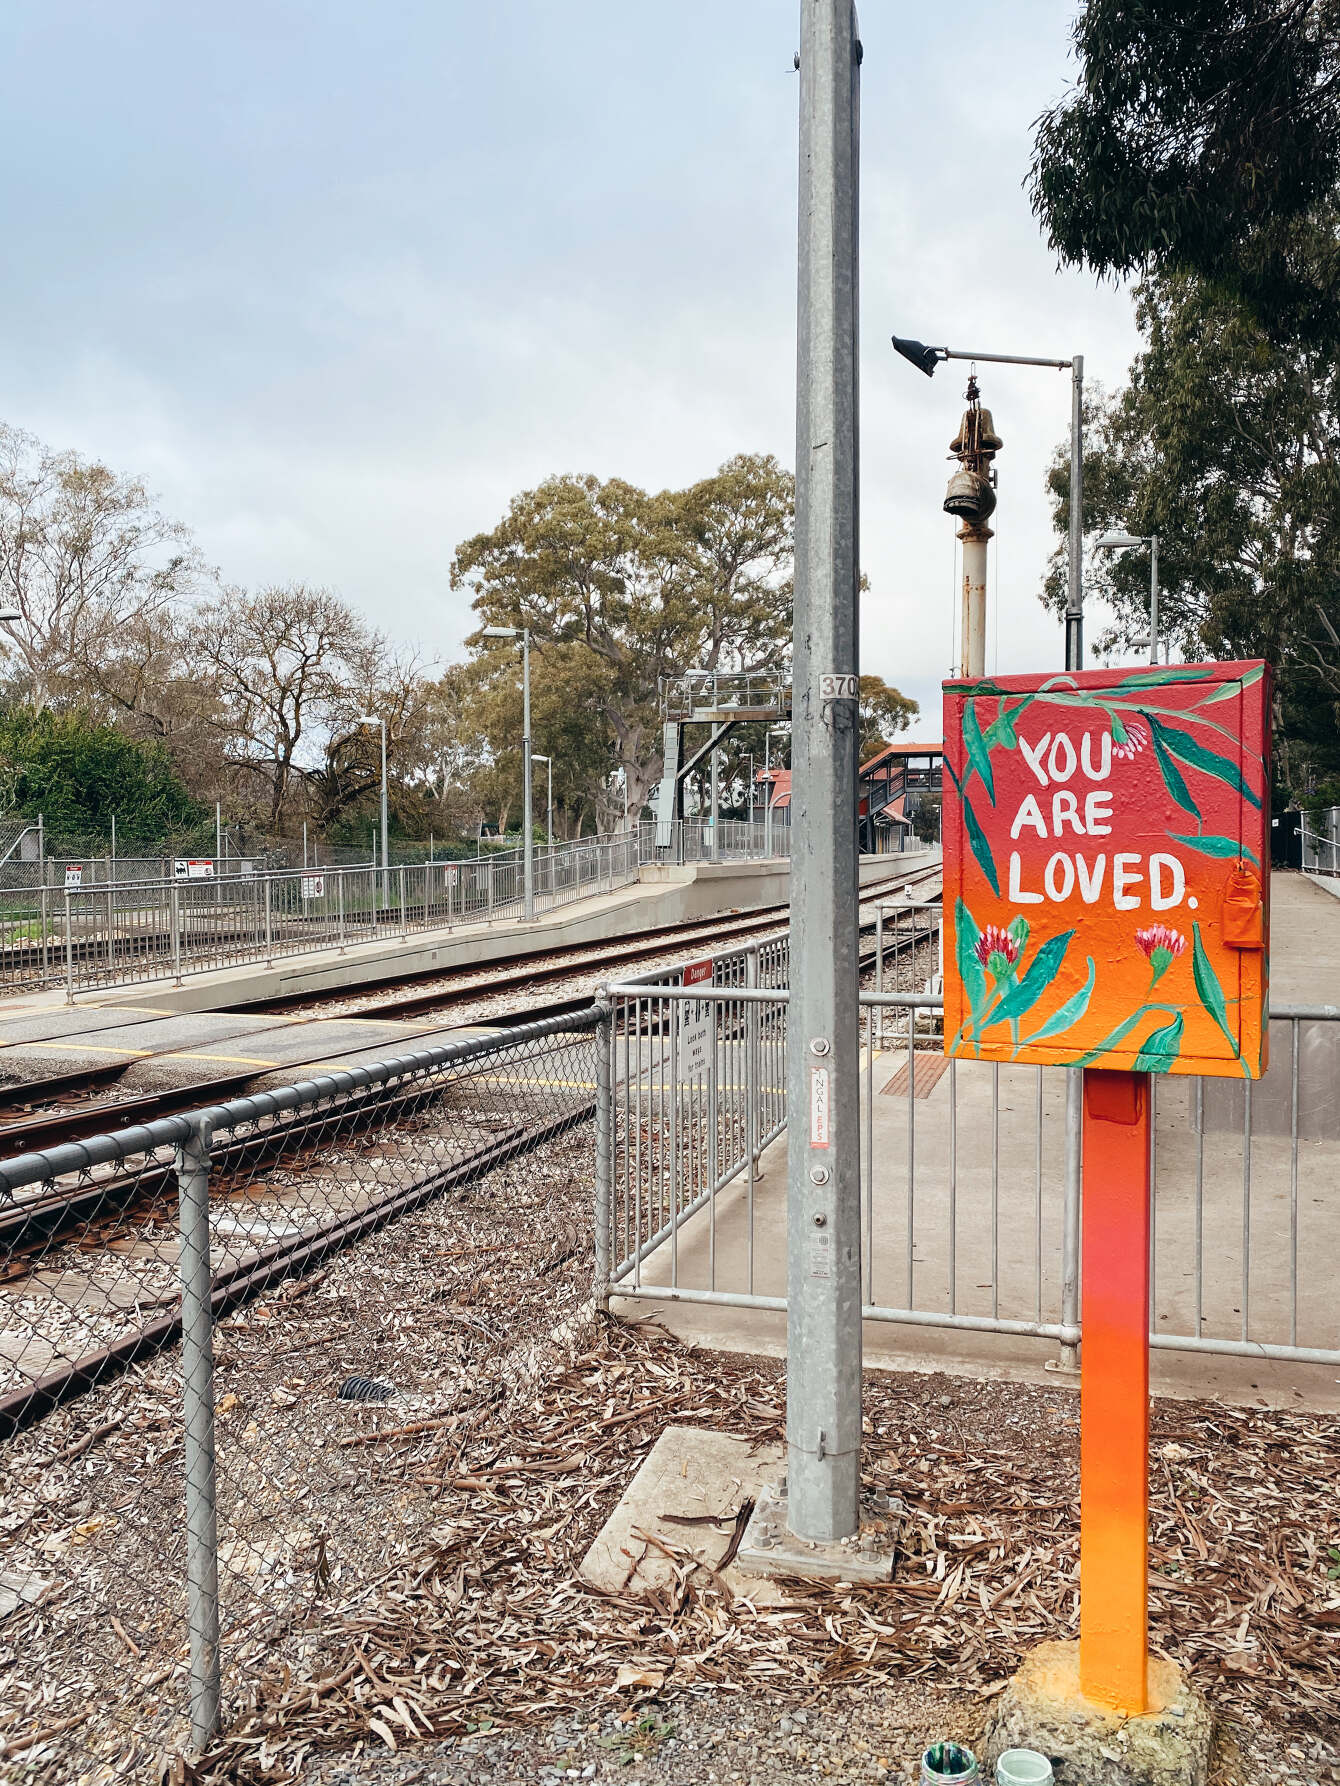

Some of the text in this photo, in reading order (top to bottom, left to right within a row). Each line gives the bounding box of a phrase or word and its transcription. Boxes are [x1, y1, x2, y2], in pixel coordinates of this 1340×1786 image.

[1018, 731, 1112, 786] YOU
[1010, 790, 1114, 840] ARE
[1009, 851, 1199, 911] LOVED.
[690, 967, 706, 980] Danger
